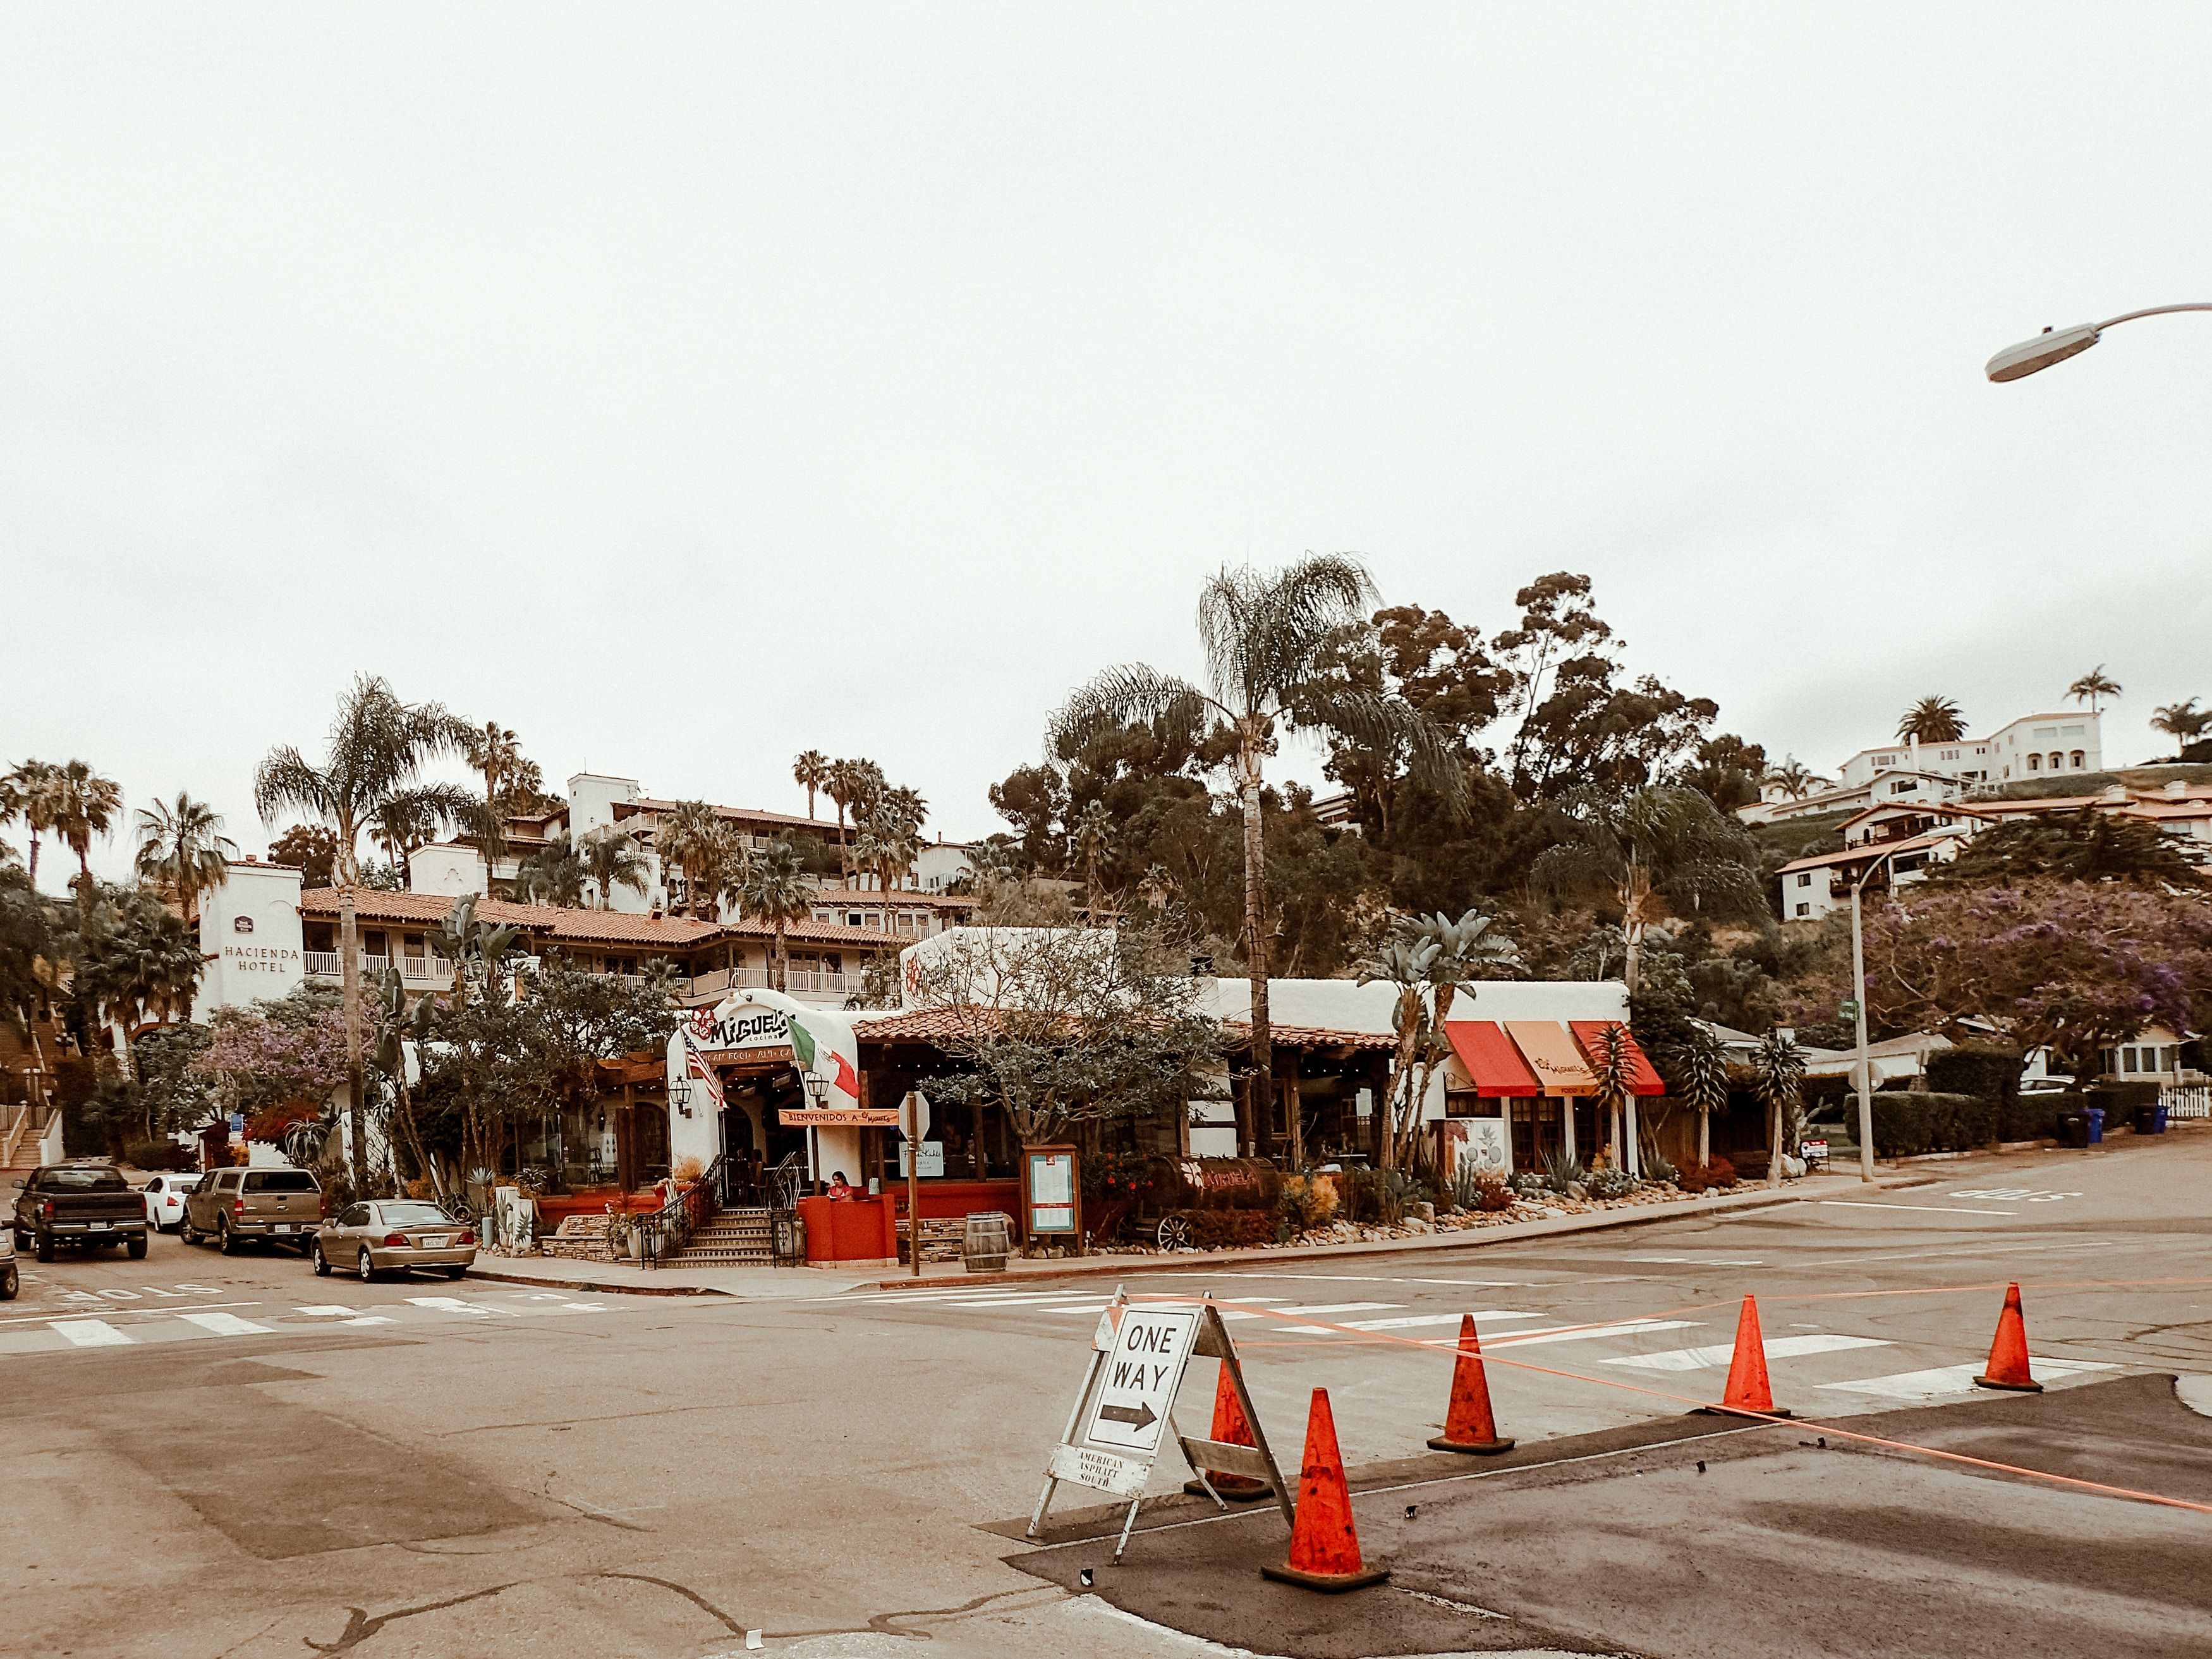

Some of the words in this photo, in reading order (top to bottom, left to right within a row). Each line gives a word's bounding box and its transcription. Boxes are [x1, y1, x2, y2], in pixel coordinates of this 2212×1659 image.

[225, 946, 298, 959] HACIENDA
[239, 961, 285, 972] HOTEL
[1127, 1325, 1177, 1353] ONE
[1113, 1361, 1169, 1392] WAY
[1078, 1452, 1124, 1469] AMERICAN
[1078, 1462, 1119, 1478] ASPHALT
[1079, 1473, 1110, 1487] SOUTH
